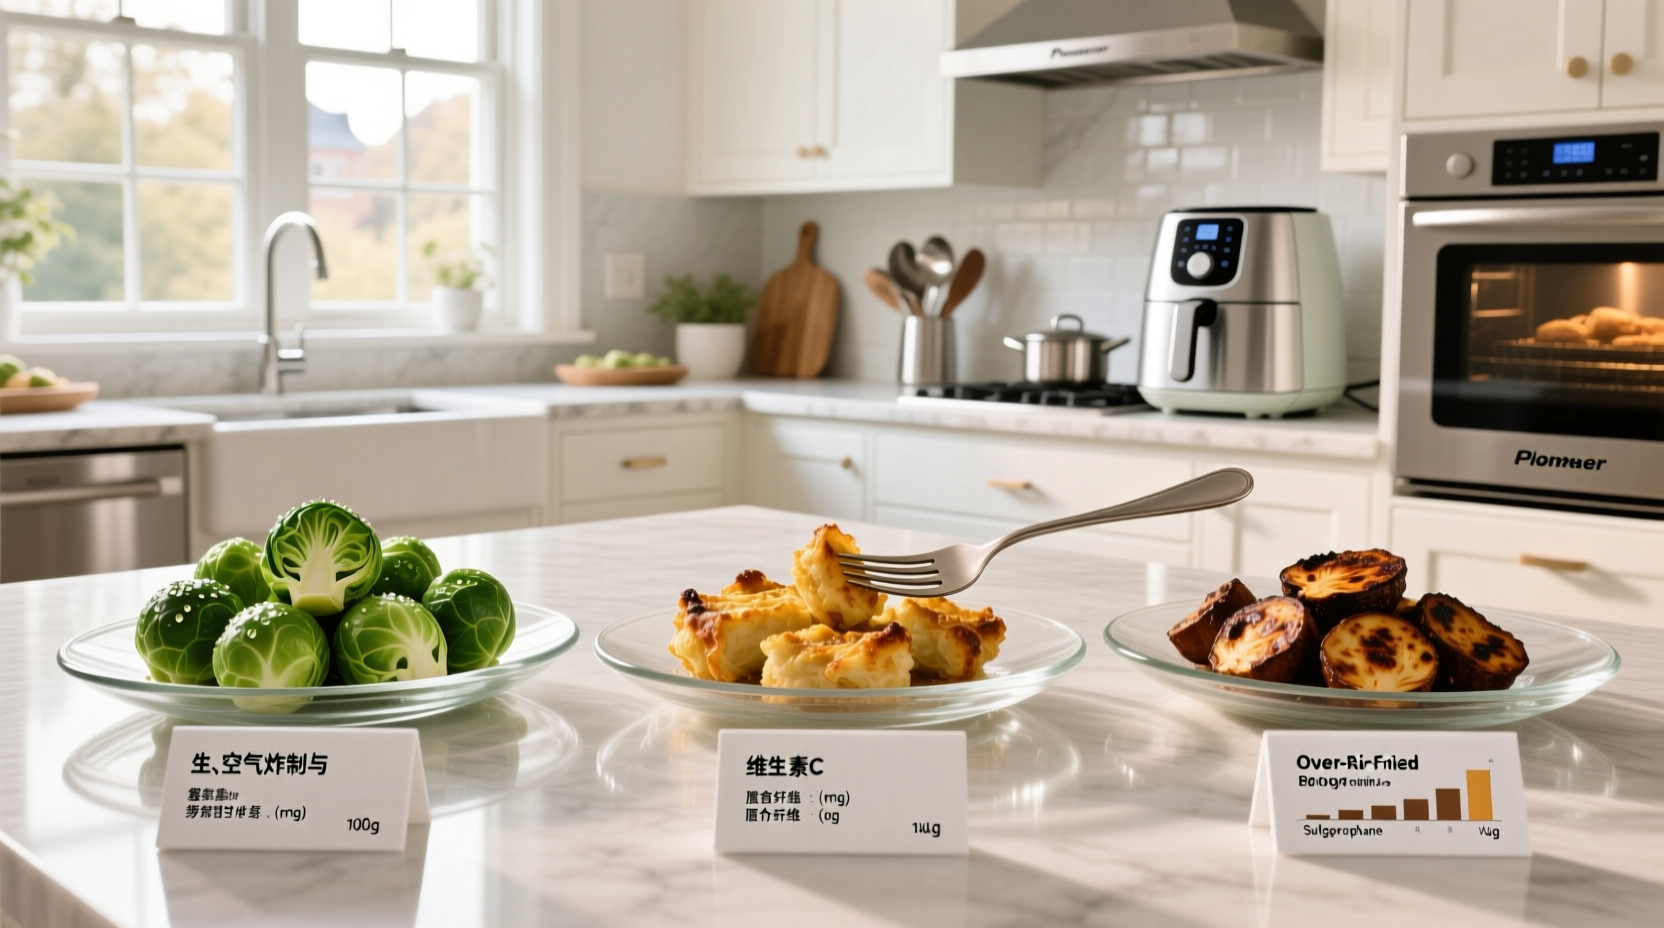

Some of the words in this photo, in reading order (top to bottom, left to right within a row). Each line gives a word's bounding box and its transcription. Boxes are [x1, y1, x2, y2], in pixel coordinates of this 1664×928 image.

[190, 751, 328, 776] 生、空气炸制与
[745, 754, 824, 778] 维生素C
[819, 789, 851, 807] (mg)
[274, 804, 307, 822] (mg)
[346, 817, 380, 835] 100g
